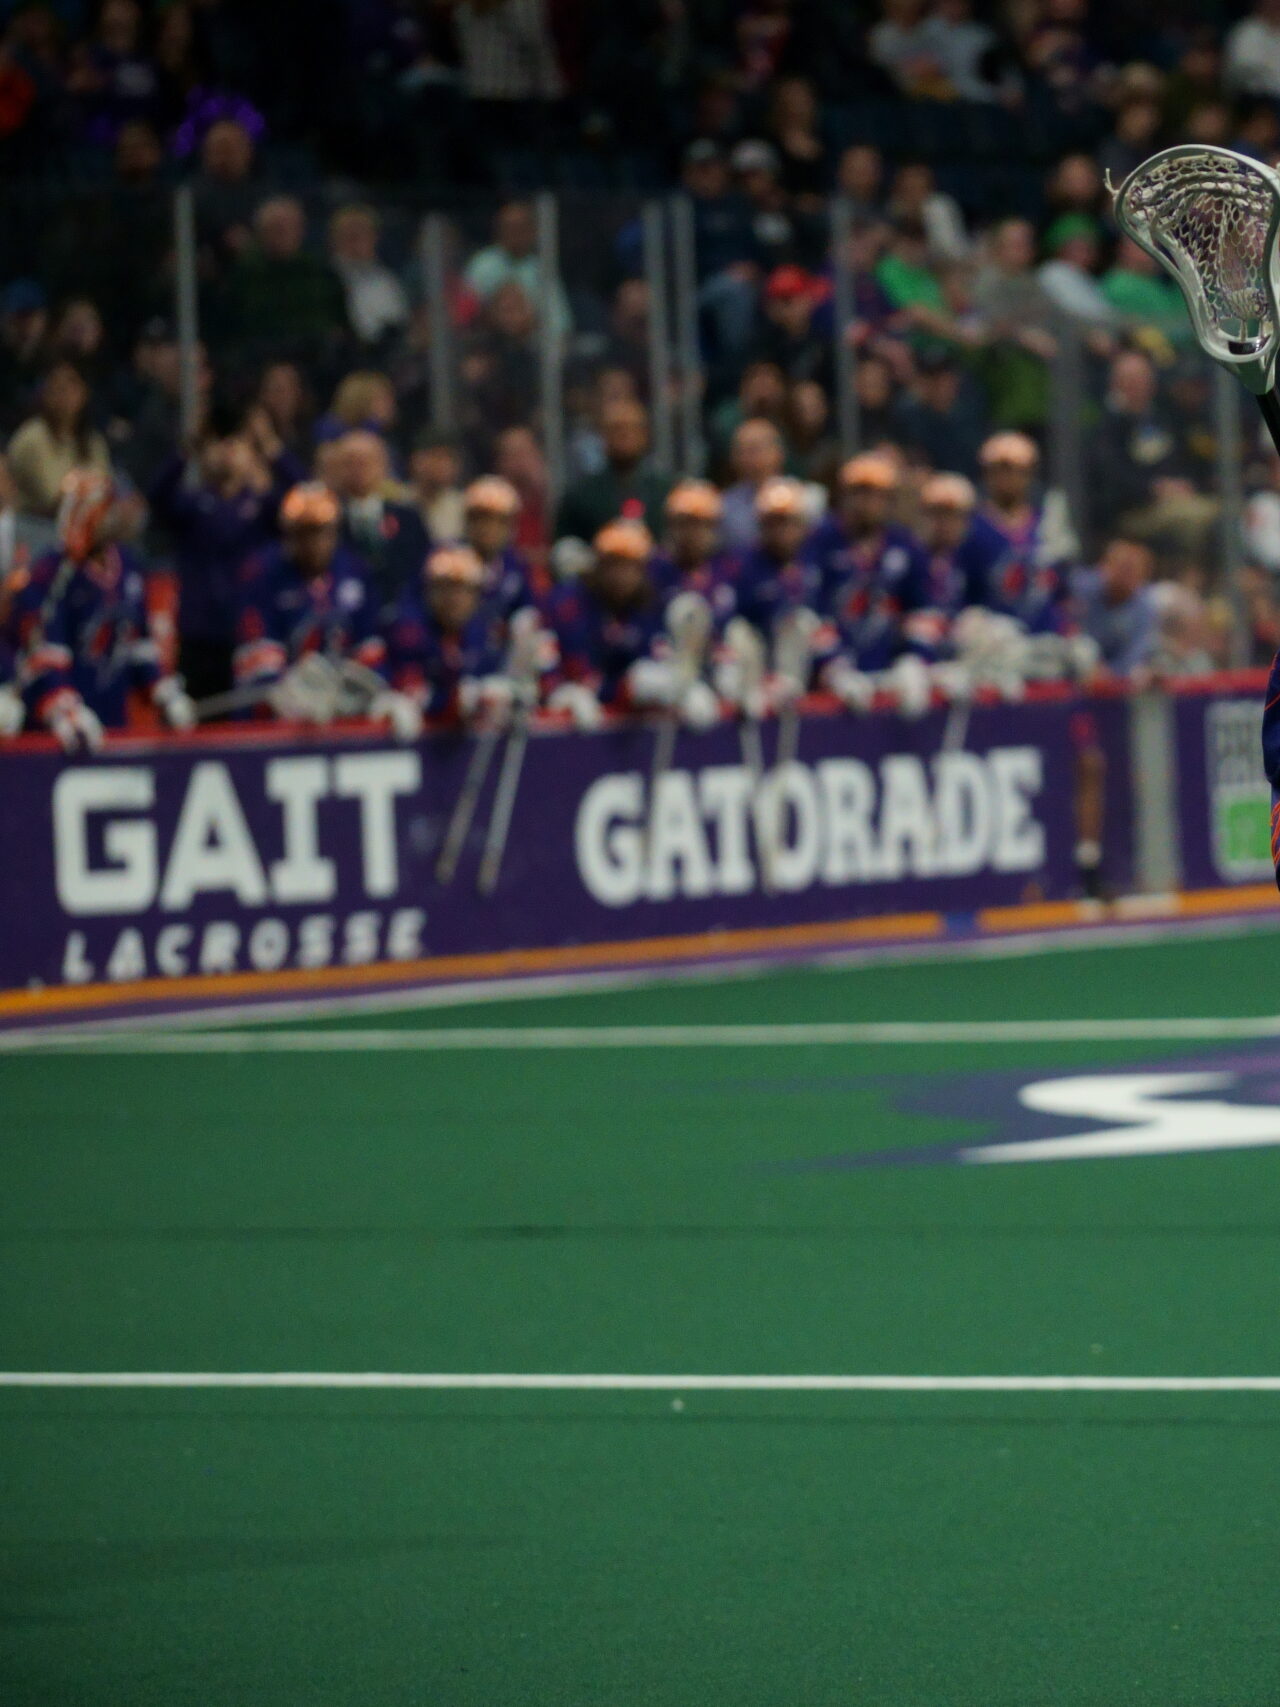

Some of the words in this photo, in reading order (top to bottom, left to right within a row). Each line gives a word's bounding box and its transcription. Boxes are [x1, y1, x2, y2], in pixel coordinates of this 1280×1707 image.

[53, 751, 423, 916] GAIT
[574, 745, 1044, 908] GATORADE
[63, 909, 427, 984] LACROSSE
